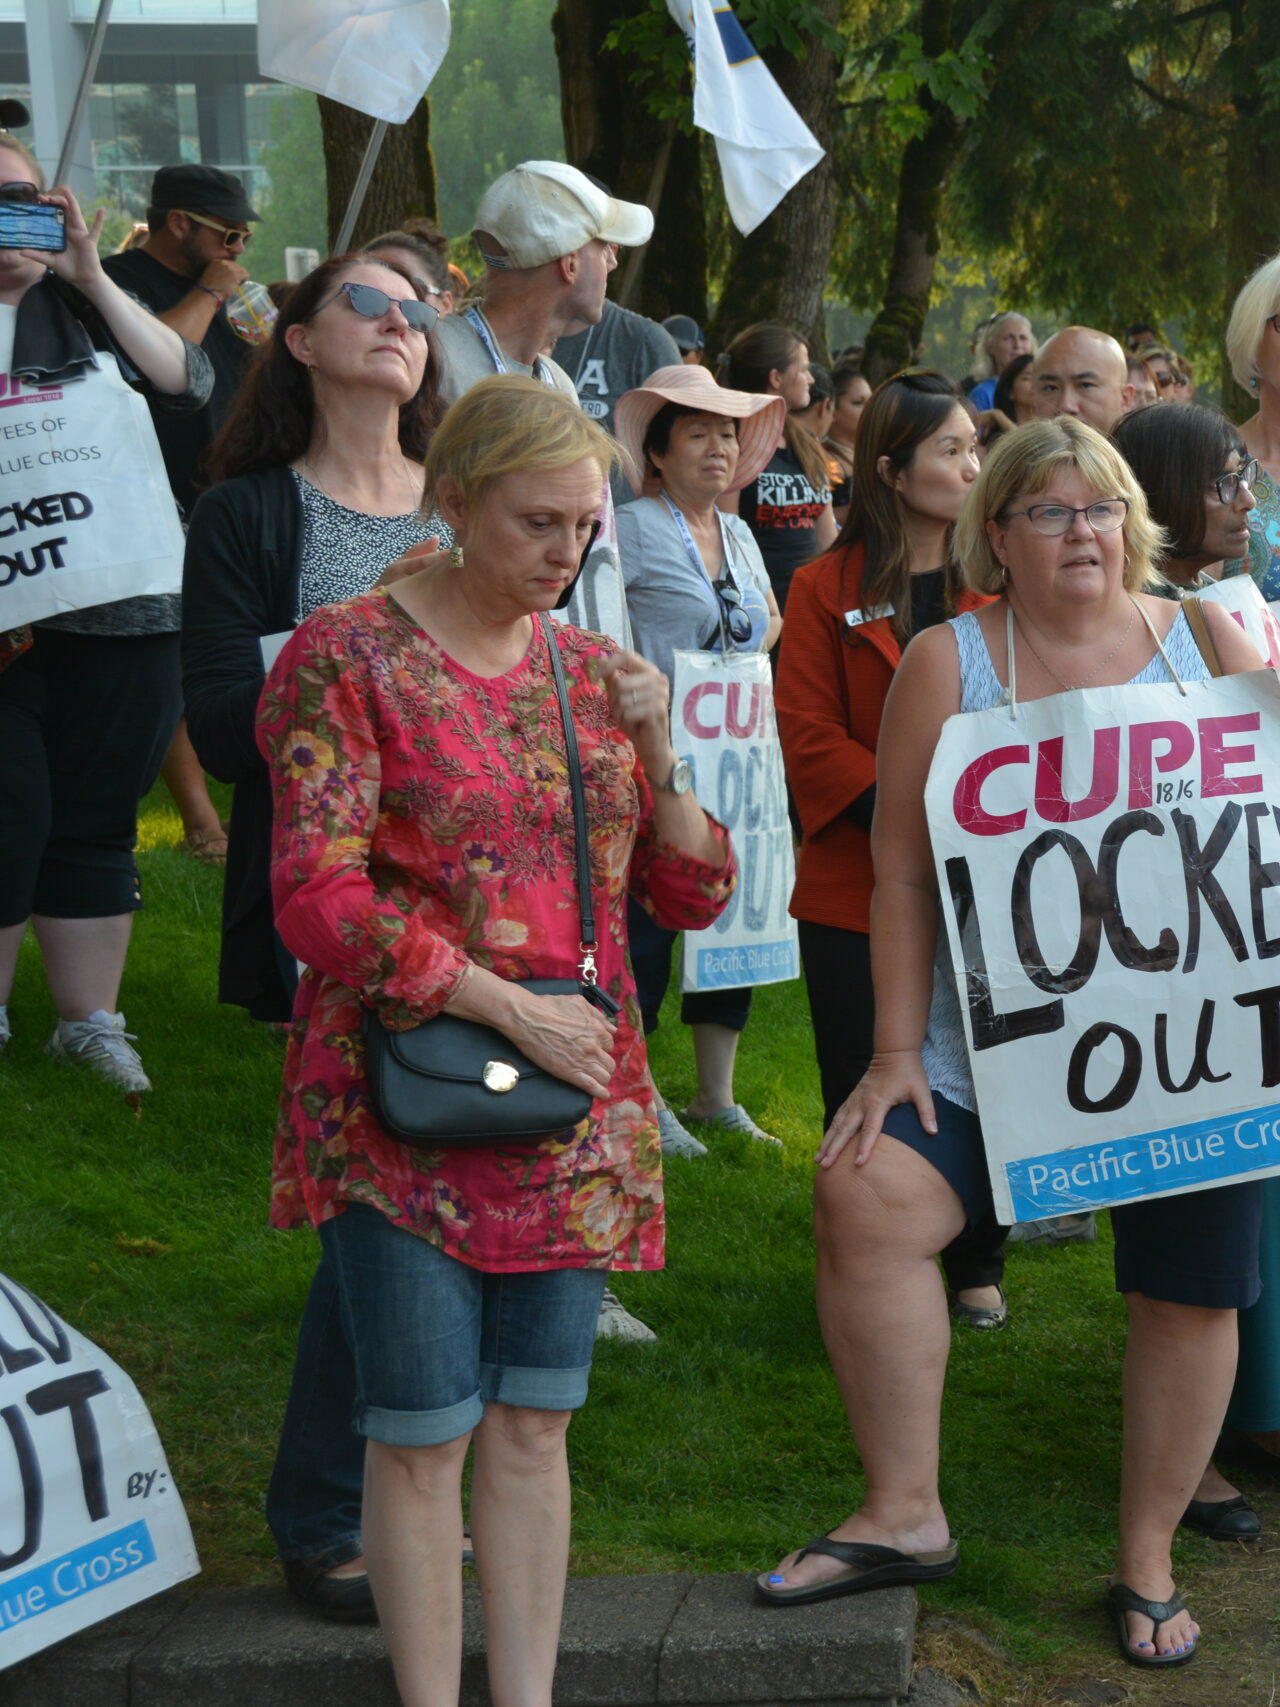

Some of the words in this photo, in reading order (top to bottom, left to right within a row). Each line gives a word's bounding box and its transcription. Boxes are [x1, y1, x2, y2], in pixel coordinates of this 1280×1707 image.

[0, 421, 37, 440] EES
[41, 417, 67, 433] OF
[38, 445, 102, 466] CROSS
[758, 472, 793, 487] STOP
[757, 485, 832, 506] KILLING
[953, 712, 1263, 837] CUPE
[1156, 779, 1194, 804] 1816
[704, 949, 745, 973] Pacific
[747, 946, 781, 969] Blue
[1027, 1147, 1142, 1196] Pacific
[1147, 1133, 1225, 1170] Blue
[127, 1468, 168, 1499] BY:
[52, 1538, 144, 1597] Cross
